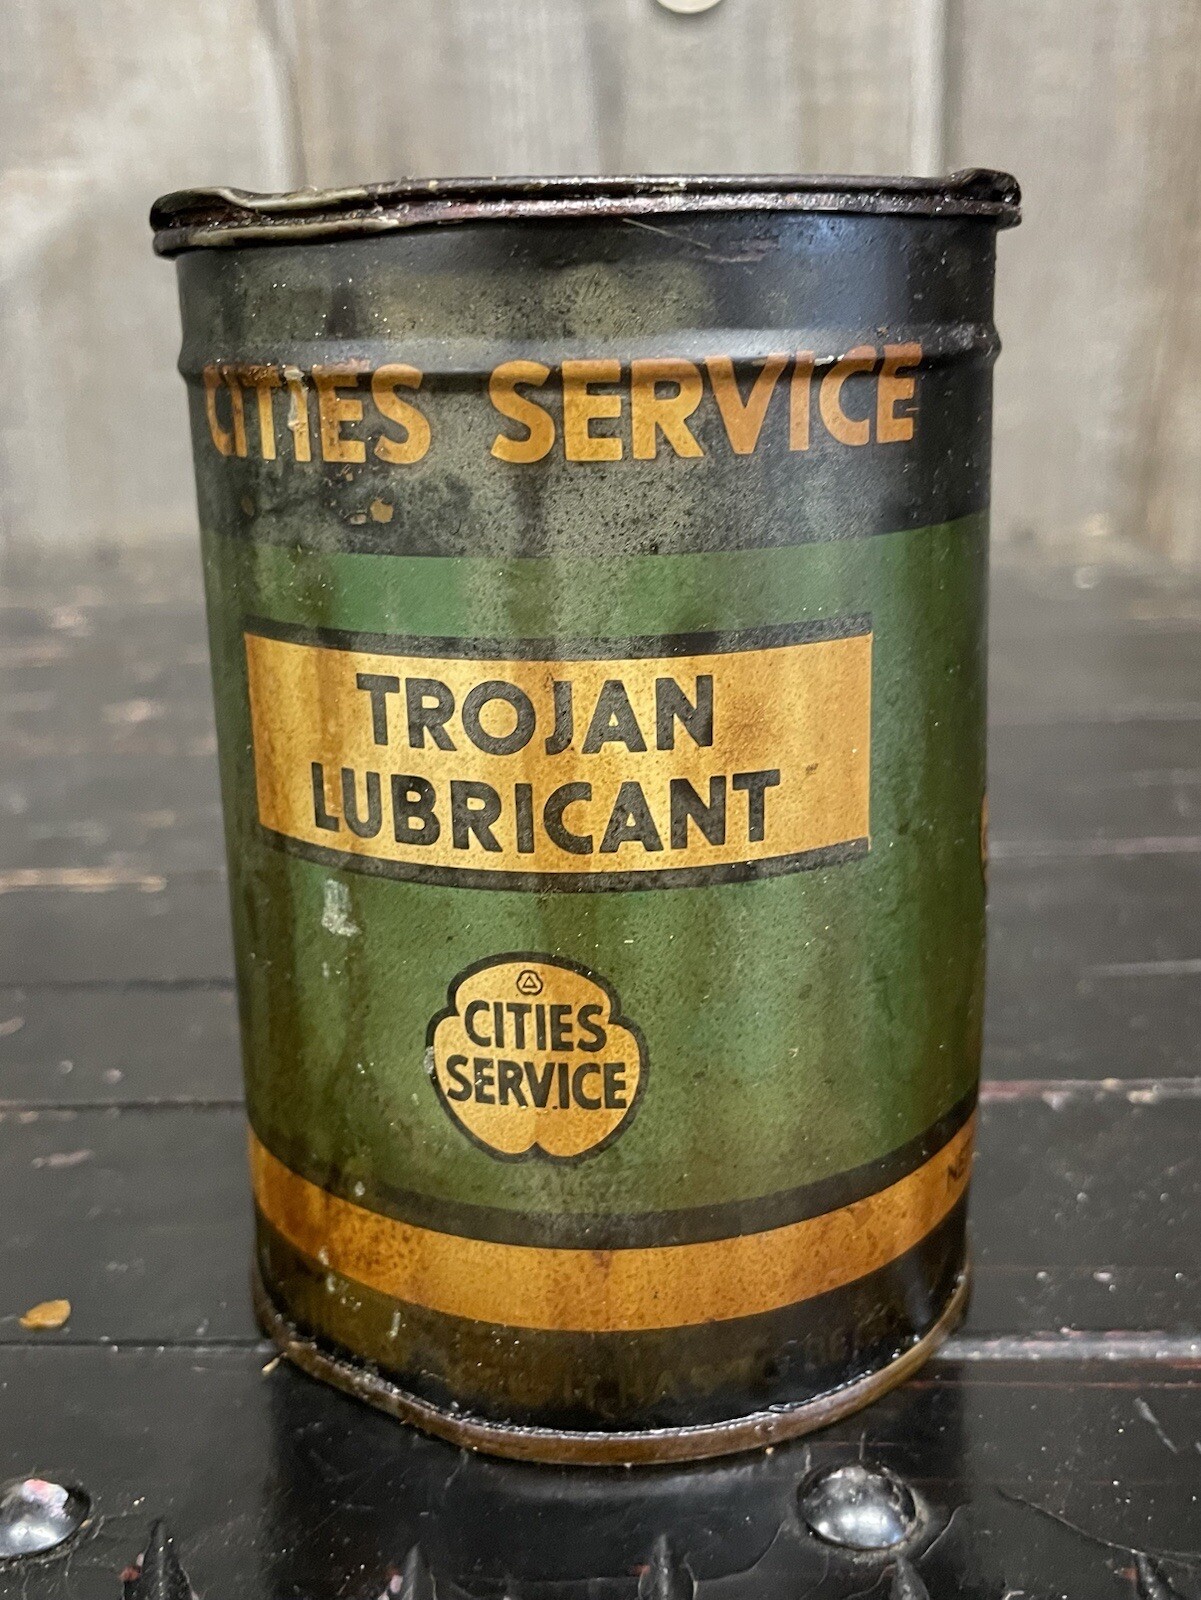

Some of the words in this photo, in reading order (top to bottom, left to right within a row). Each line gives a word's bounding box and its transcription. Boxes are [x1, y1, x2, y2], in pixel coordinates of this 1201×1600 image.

[203, 358, 431, 464] CITIES
[490, 342, 922, 463] SERVICE
[356, 672, 714, 756] TROJAN
[311, 762, 781, 854] LUBRICANT
[464, 999, 608, 1053] CITIES
[446, 1053, 628, 1110] SERVICE
